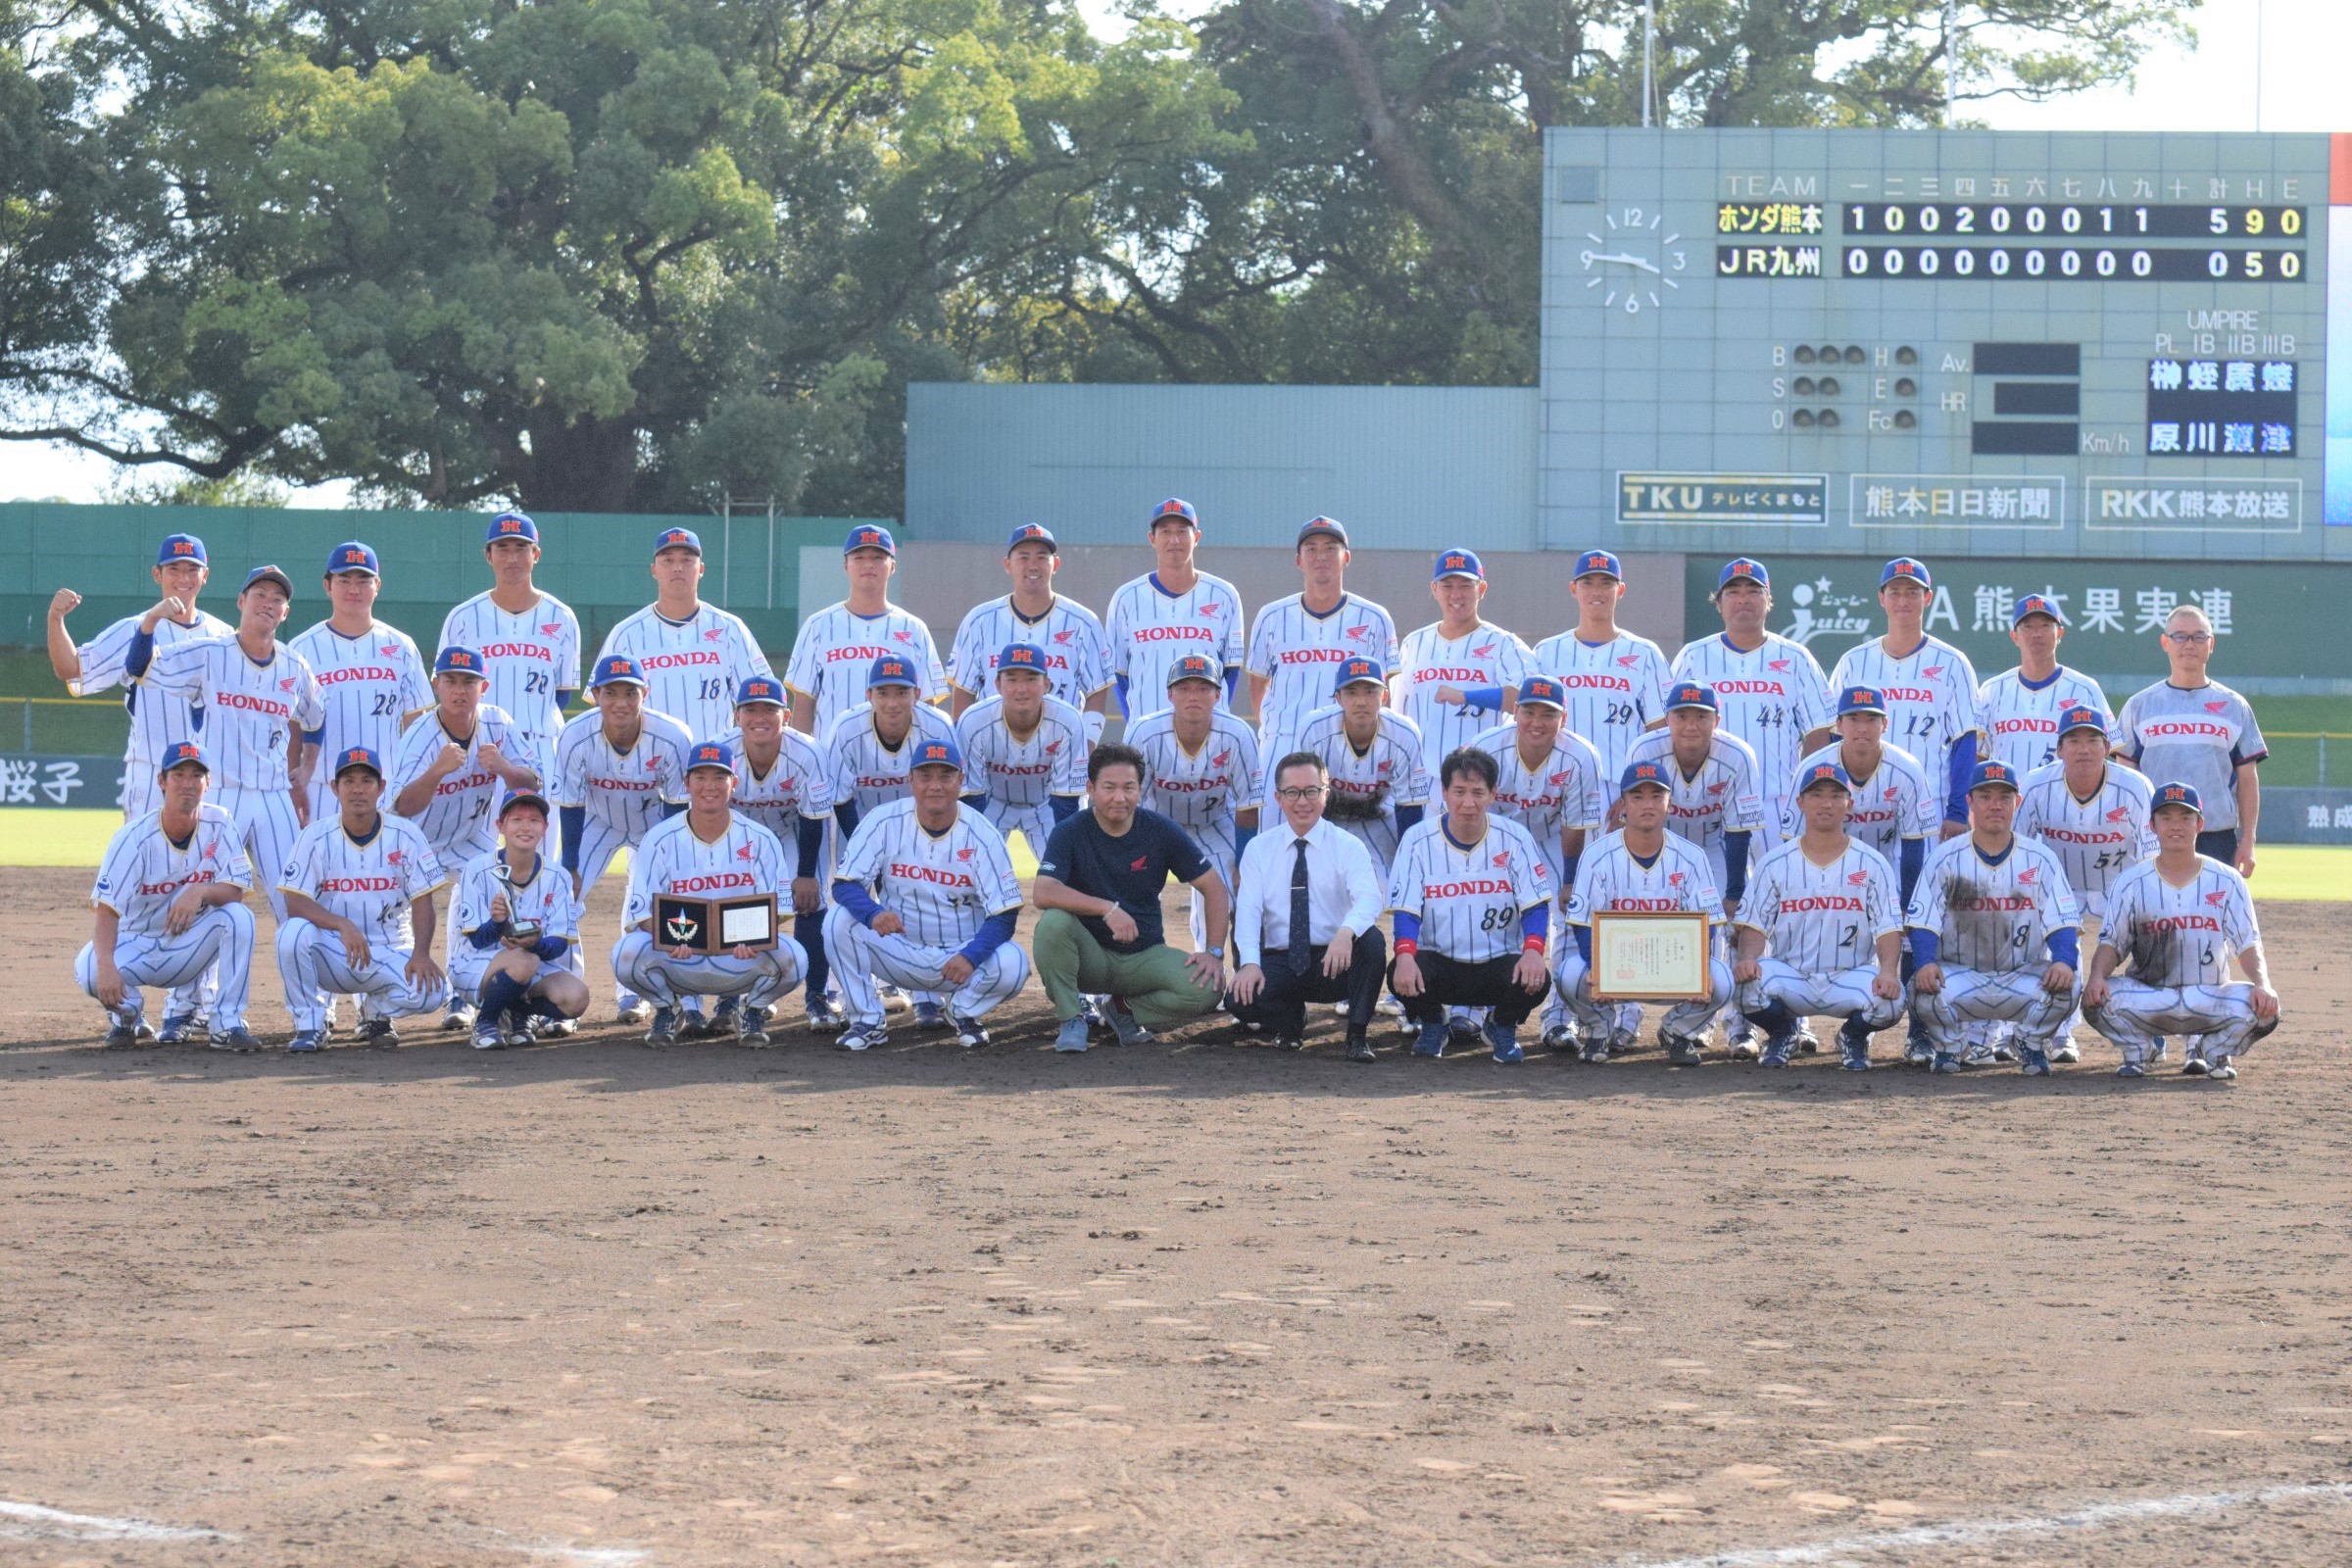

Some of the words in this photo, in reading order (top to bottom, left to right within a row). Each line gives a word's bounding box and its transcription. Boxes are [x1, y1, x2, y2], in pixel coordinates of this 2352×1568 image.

[1725, 175, 1816, 196] TEAM
[1955, 177, 1976, 197] 四
[1990, 177, 2010, 197] 五
[2026, 176, 2046, 197] 六
[2062, 177, 2082, 198] 七
[2097, 177, 2117, 198] 八
[2132, 177, 2153, 199] 九
[2246, 178, 2263, 199] H
[2283, 178, 2298, 199] E
[1624, 208, 1643, 226] 12
[1719, 203, 1823, 233] ホンダ熊本
[1852, 205, 1864, 230] 1
[1885, 206, 1904, 231] 0
[1920, 206, 1939, 231] 0
[1955, 206, 1975, 232] 2
[1990, 207, 2010, 232] 0
[2026, 207, 2045, 232] 0
[2061, 207, 2082, 232] 0
[2099, 207, 2112, 232] 1
[2135, 207, 2147, 232] 1
[2210, 208, 2229, 233] 5
[2245, 209, 2264, 234] 9
[2280, 209, 2300, 234] 0
[1673, 252, 1686, 270] 3
[1720, 246, 1821, 276] JR九州
[1848, 248, 1868, 274] 0
[1884, 249, 1903, 274] 0
[1919, 249, 1939, 274] 0
[1954, 249, 1975, 275] 0
[1989, 249, 2010, 275] 0
[2025, 249, 2045, 275] 0
[2060, 250, 2081, 275] 0
[2096, 250, 2116, 276] 0
[2132, 250, 2152, 276] 0
[2208, 251, 2228, 277] 0
[2245, 252, 2263, 277] 5
[2279, 252, 2300, 277] 0
[1625, 293, 1640, 314] 6
[2187, 310, 2259, 330] UMPIRE
[2156, 333, 2180, 354] PL
[1772, 346, 1786, 367] B
[1875, 347, 1888, 367] H
[1940, 353, 1970, 372] Av.
[1772, 378, 1785, 399] S
[1875, 379, 1886, 399] E
[1940, 391, 1966, 412] HR
[1868, 410, 1891, 430] Fc
[2082, 431, 2130, 452] Km/h
[1623, 486, 1703, 510] TKU
[1712, 491, 1821, 508] テレビくまもと
[1865, 486, 2051, 519] 熊本日日新聞
[2101, 489, 2291, 519] RKK熊本放送
[1164, 502, 1182, 514] H
[502, 520, 520, 532] H
[174, 542, 193, 555] H
[347, 550, 366, 564] H
[1446, 556, 1464, 568] H
[1590, 557, 1607, 568] H
[1734, 564, 1751, 575] H
[1895, 563, 1914, 574] H
[1134, 626, 1213, 643] HONDA
[451, 653, 470, 666] H
[640, 652, 721, 671] HONDA
[826, 645, 900, 663] HOND
[1012, 650, 1032, 662] H
[612, 662, 630, 673] H
[883, 663, 902, 675] H
[1185, 658, 1204, 670] H
[1350, 662, 1369, 675] H
[317, 667, 397, 686] HONDA
[1412, 668, 1488, 684] HONDA
[697, 678, 721, 701] 18
[750, 683, 768, 696] H
[1682, 689, 1700, 702] H
[1854, 691, 1872, 704] H
[1881, 688, 1934, 703] ONDA
[217, 691, 291, 718] HONDA
[370, 693, 397, 716] 28
[1603, 703, 1634, 725] 29
[1756, 705, 1785, 729] 44
[2073, 710, 2091, 722] H
[1903, 715, 1936, 738] 12
[1994, 718, 2058, 735] HOND
[2144, 722, 2230, 741] HONDA
[179, 745, 199, 759] H
[350, 751, 368, 762] H
[701, 748, 719, 760] H
[927, 746, 946, 760] H
[1637, 766, 1655, 778] H
[1986, 766, 2005, 779] H
[0, 759, 83, 804] 桜子
[856, 775, 909, 788] HON
[2166, 788, 2184, 800] H
[1667, 803, 1724, 818] ONDA
[1843, 810, 1895, 823] ONDA
[2043, 827, 2126, 844] HONDA
[2093, 850, 2128, 869] 57
[671, 872, 756, 894] HONDA
[891, 863, 973, 887] HONDA
[1424, 879, 1513, 899] HONDA
[1780, 896, 1865, 913] HONDA
[1481, 906, 1514, 932] 89
[2141, 915, 2221, 933] HONDA
[1838, 924, 1858, 947] 2
[2013, 924, 2031, 948] 8
